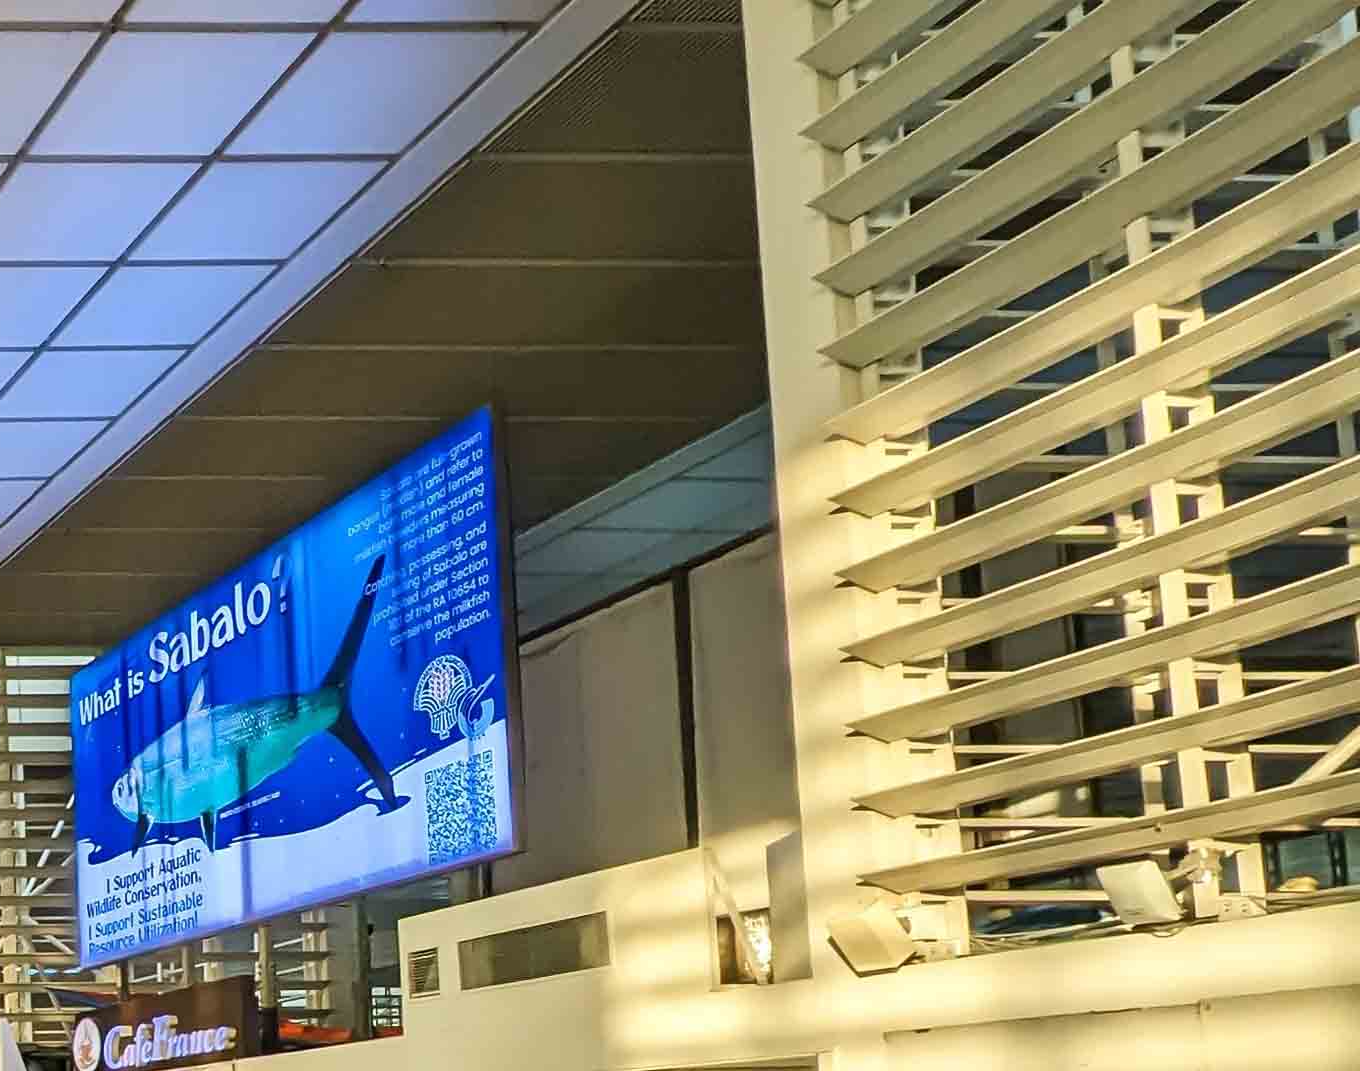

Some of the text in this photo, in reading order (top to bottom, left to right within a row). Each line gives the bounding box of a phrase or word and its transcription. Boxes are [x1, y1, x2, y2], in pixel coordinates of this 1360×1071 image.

[472, 449, 483, 463] to
[451, 509, 464, 526] 60
[465, 519, 488, 543] and
[79, 677, 122, 726] What
[127, 669, 144, 699] is
[113, 862, 155, 892] Support
[158, 847, 202, 875] Aquatic
[86, 871, 202, 919] Wildlife Conservation,
[95, 912, 134, 938] Support
[138, 892, 203, 925] Sustainable
